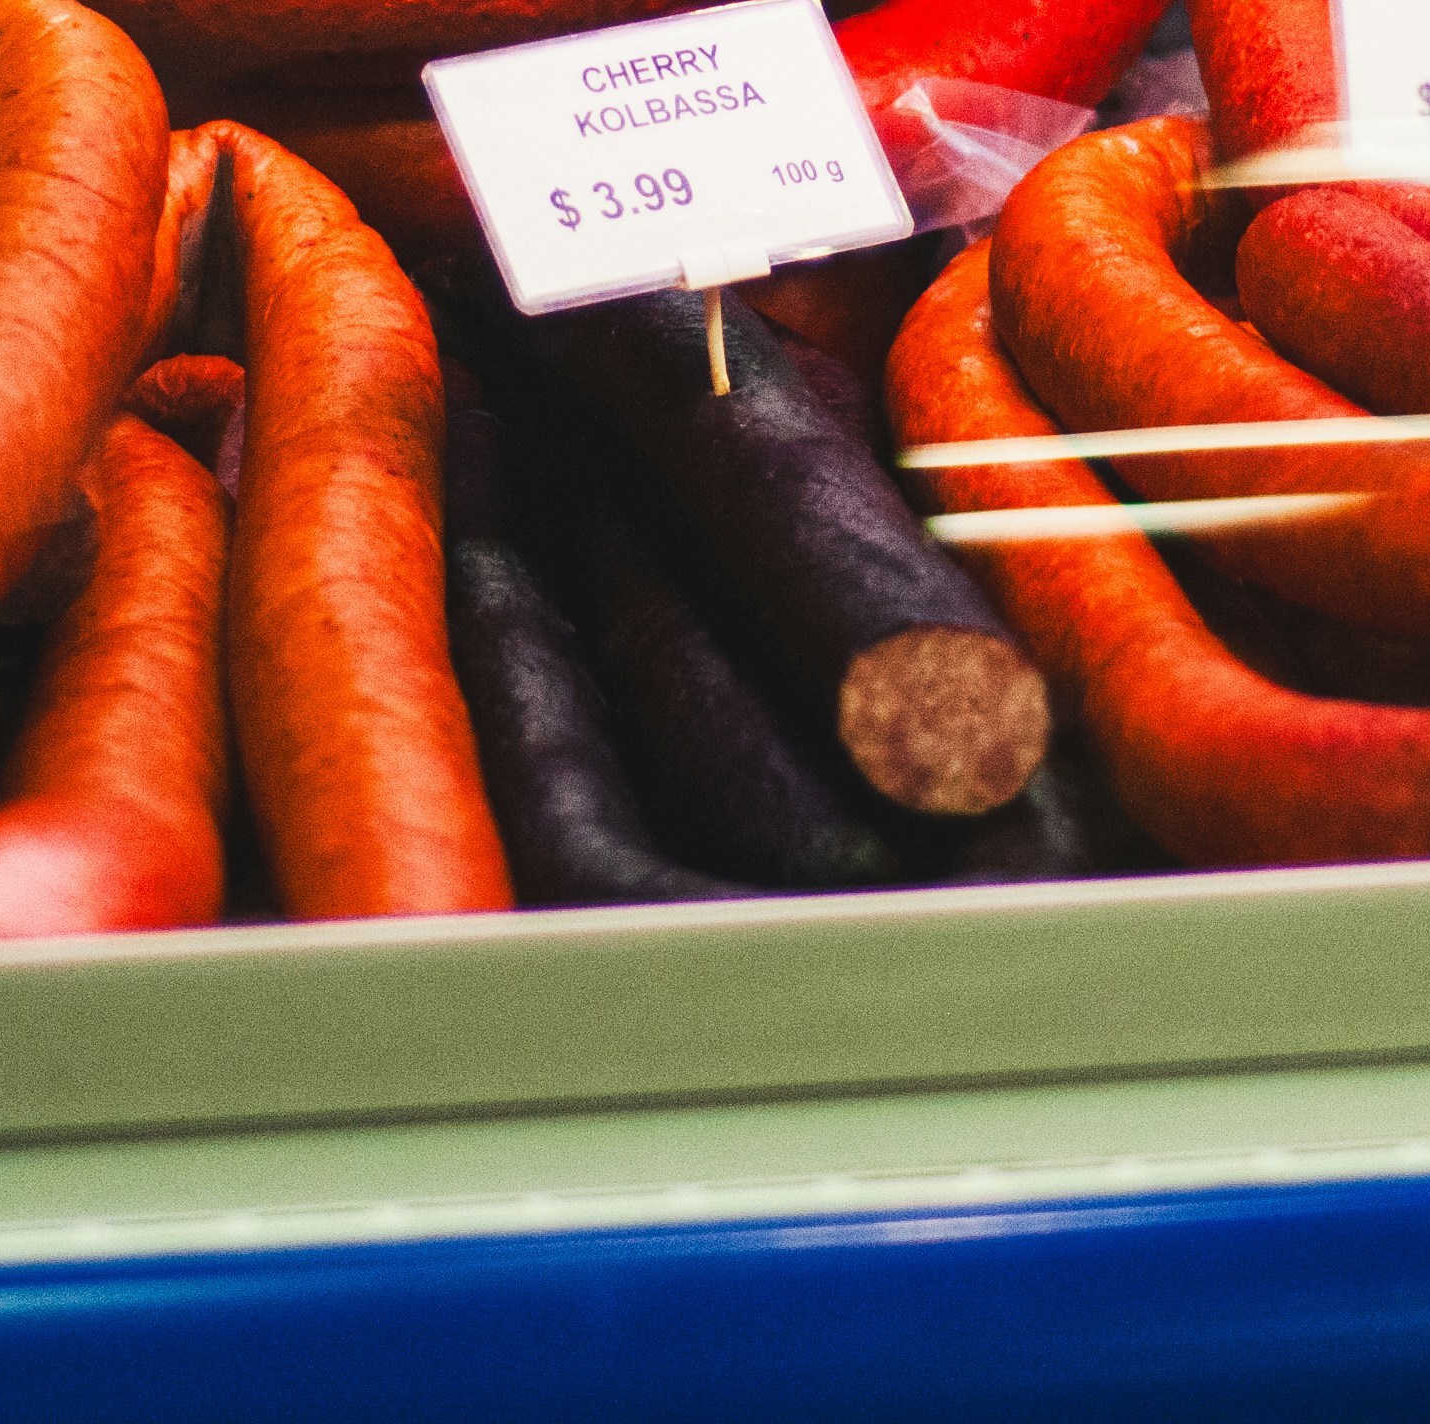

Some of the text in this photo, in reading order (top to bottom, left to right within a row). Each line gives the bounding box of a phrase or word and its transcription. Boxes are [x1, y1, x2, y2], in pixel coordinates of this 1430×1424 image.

[581, 44, 722, 94] CHERRY
[573, 81, 767, 138] KOLBASSA
[549, 158, 845, 232] $ 3.99 100 g
